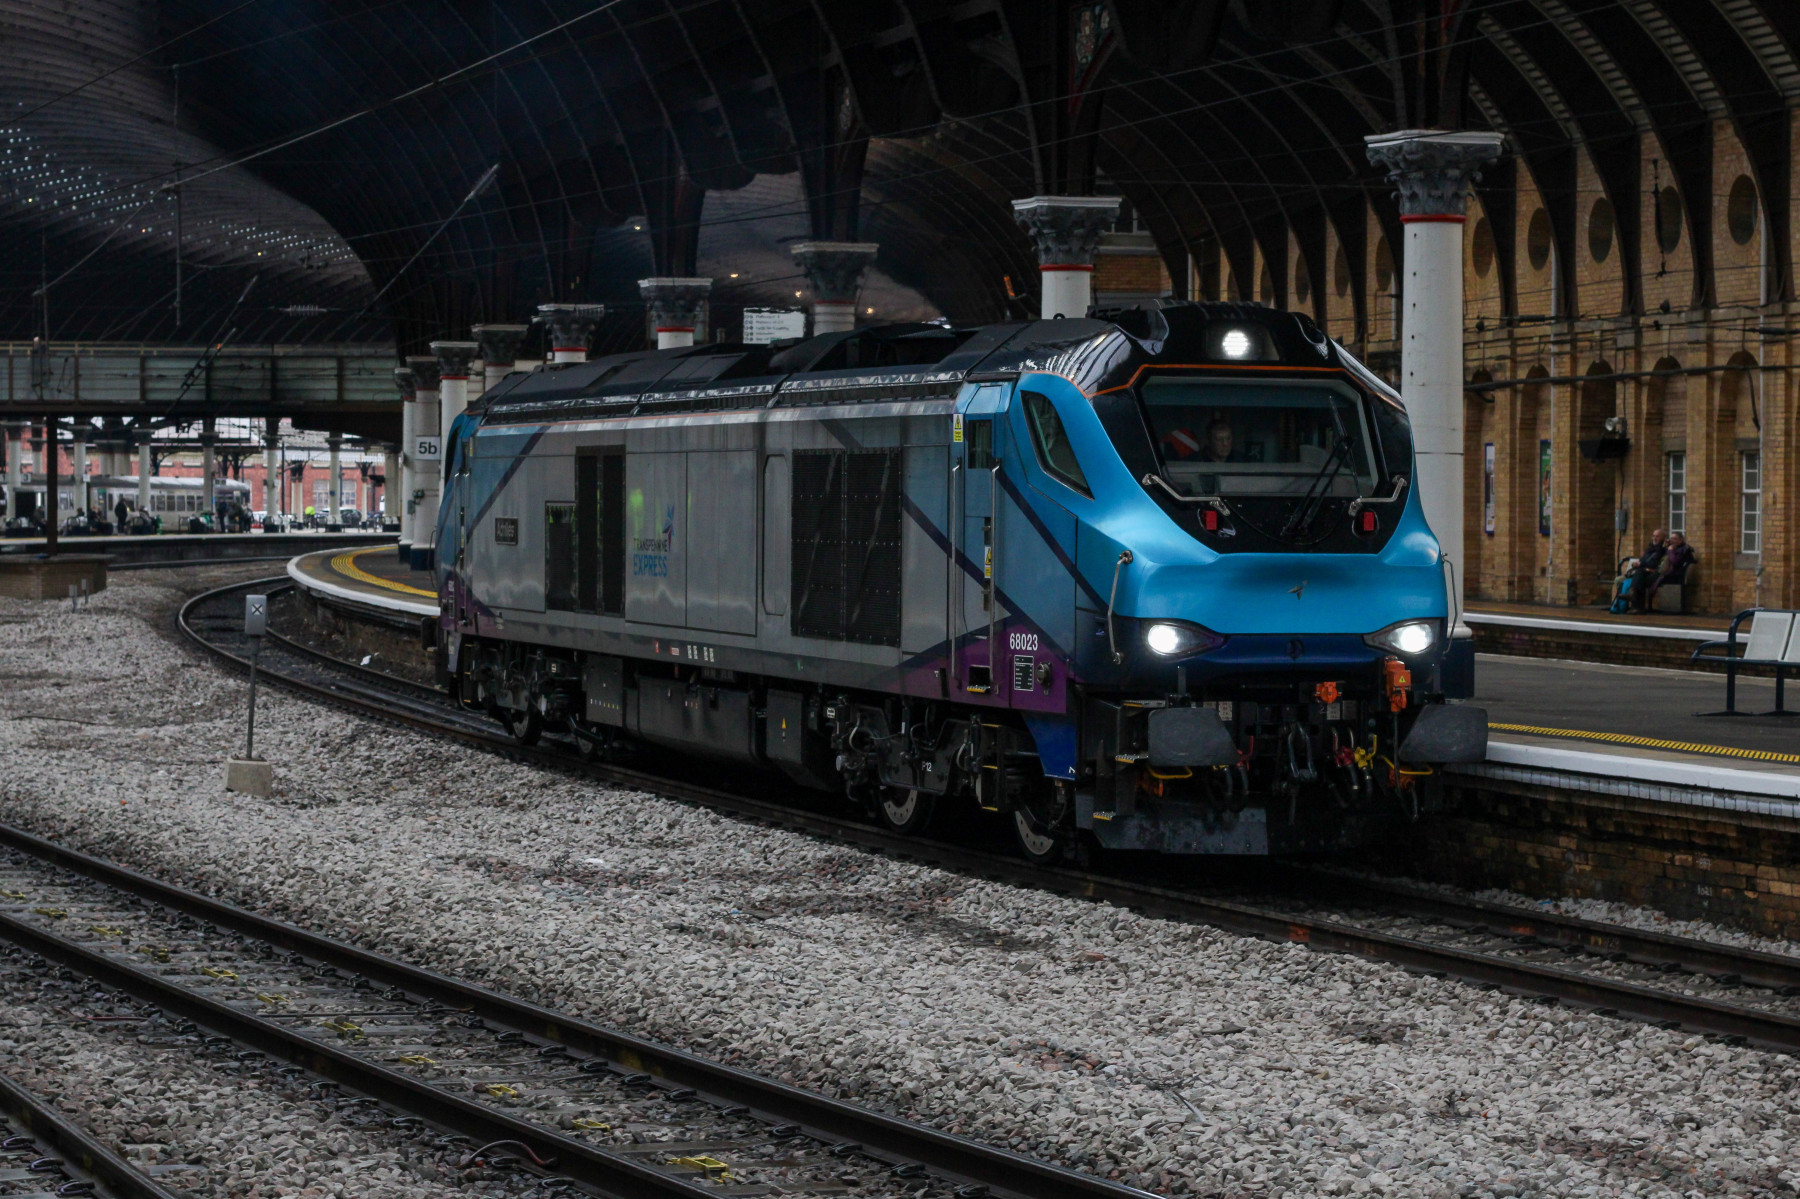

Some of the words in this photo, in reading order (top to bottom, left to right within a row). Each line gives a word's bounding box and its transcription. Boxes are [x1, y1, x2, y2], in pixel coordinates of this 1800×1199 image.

[418, 441, 437, 454] 5b
[633, 554, 667, 577] EXPRESS
[1010, 632, 1038, 651] 68023
